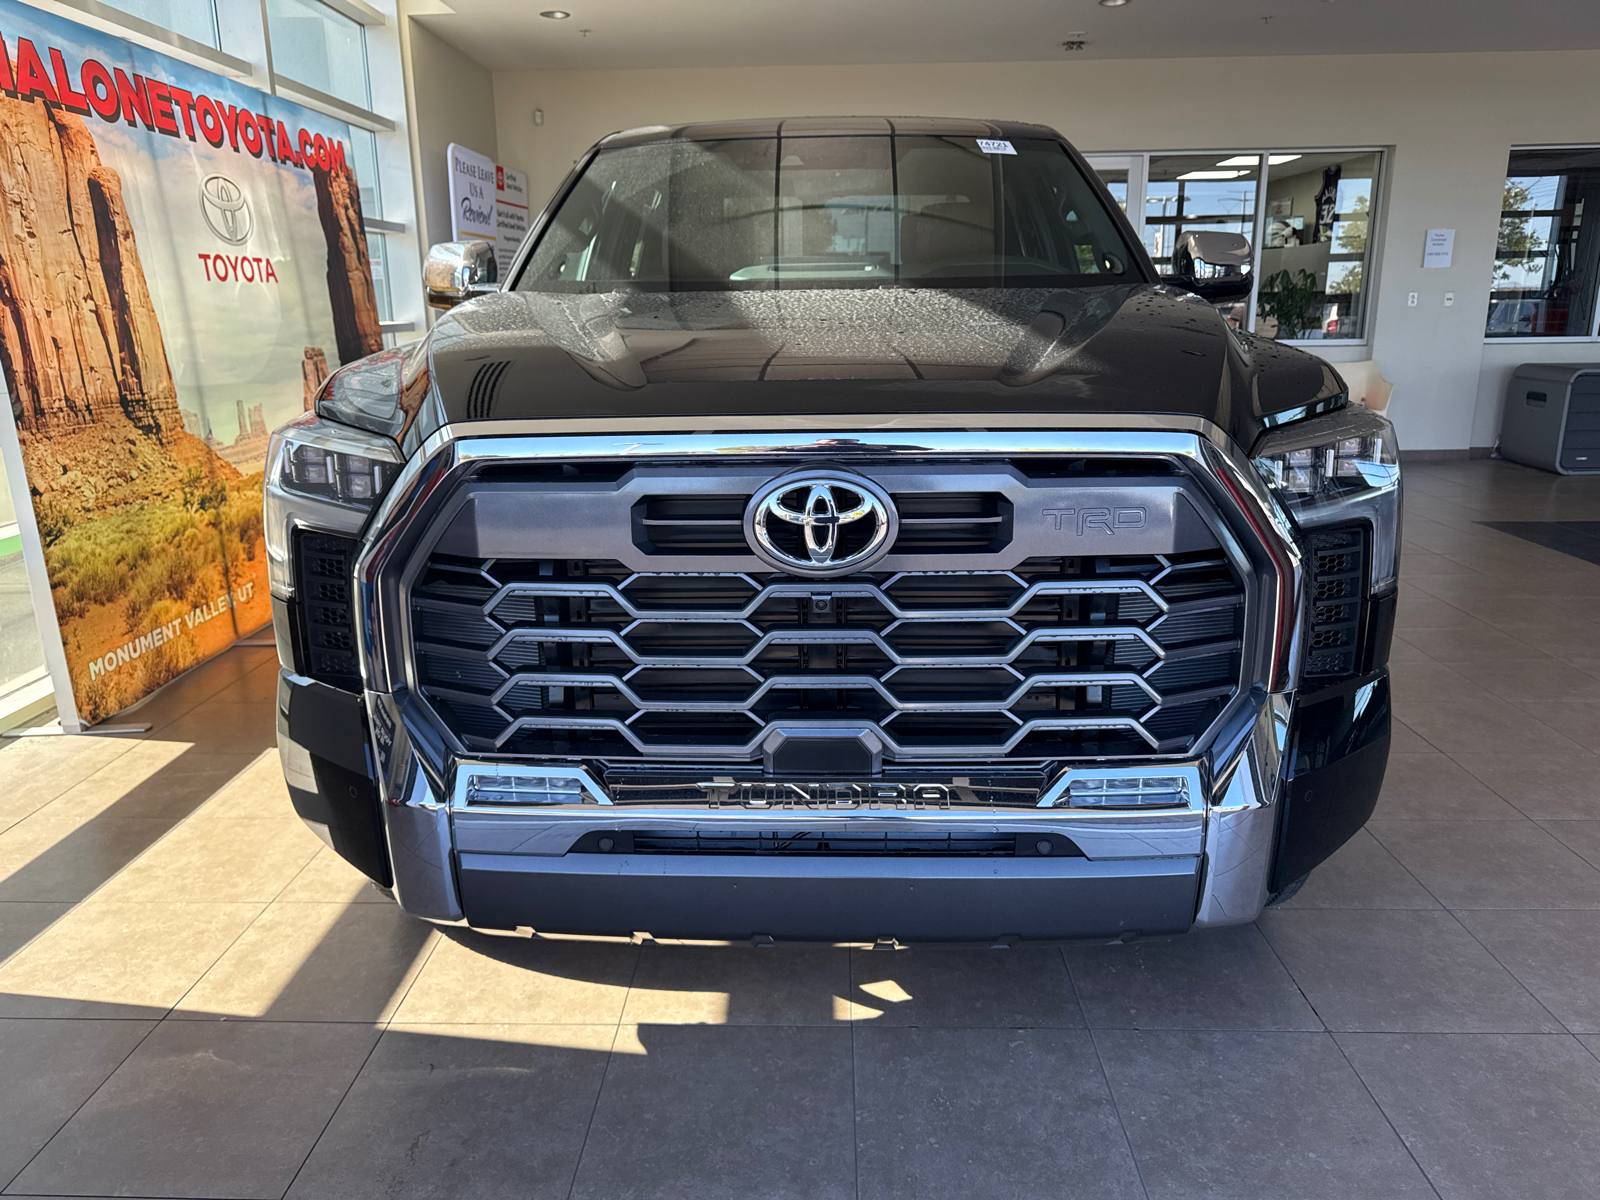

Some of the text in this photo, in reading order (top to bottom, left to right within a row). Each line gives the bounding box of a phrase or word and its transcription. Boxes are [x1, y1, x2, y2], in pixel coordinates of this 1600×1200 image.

[455, 157, 495, 185] PLEASE LEAVE
[469, 182, 485, 199] US A
[461, 197, 493, 226] Review!
[1319, 204, 1335, 224] 32
[198, 253, 279, 284] TOYOTA
[1042, 506, 1147, 536] TRD
[88, 617, 183, 681] MONUMENT
[237, 582, 254, 603] UT
[695, 781, 951, 810] TUNDRA
